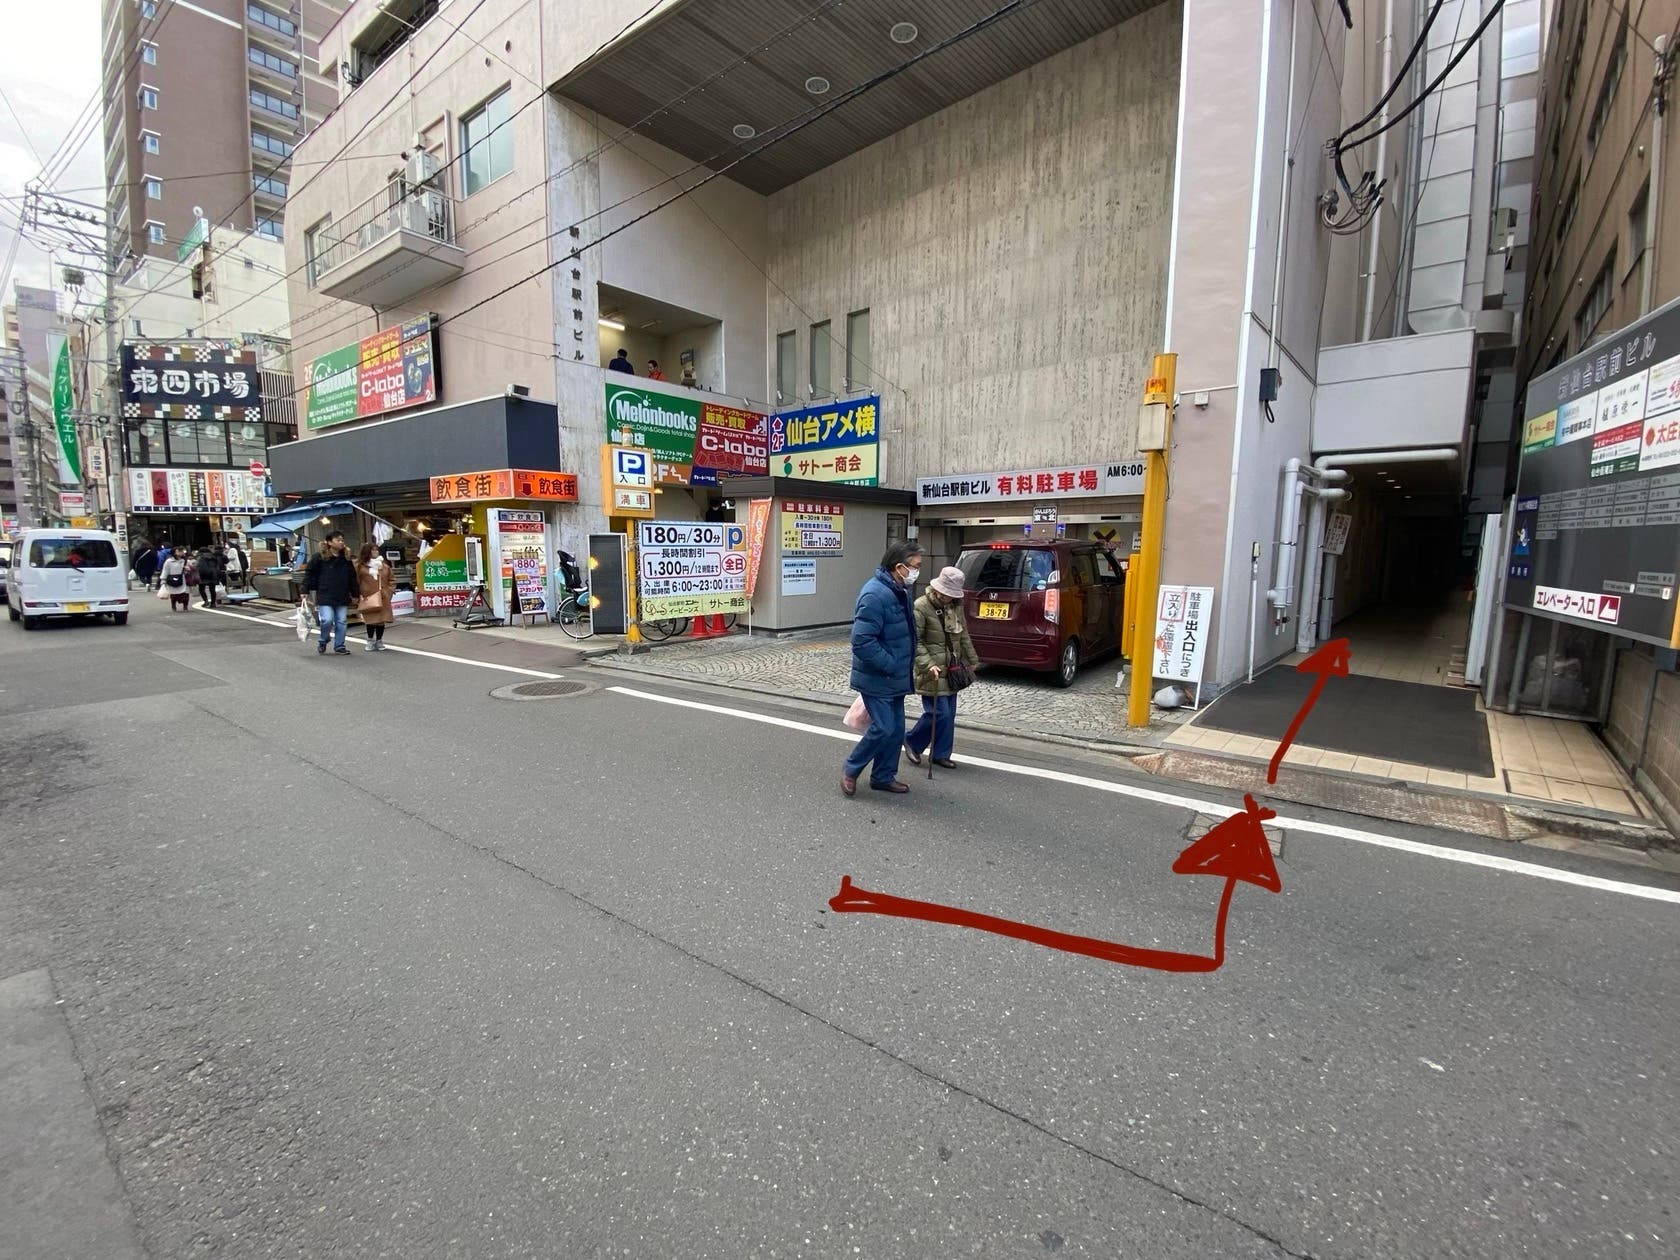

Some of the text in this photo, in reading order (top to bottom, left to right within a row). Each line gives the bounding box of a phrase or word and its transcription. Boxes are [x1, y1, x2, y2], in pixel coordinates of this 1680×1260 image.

[569, 226, 583, 361] 新仙台駅前ビル
[130, 366, 250, 399] 東四市場
[361, 374, 405, 397] C-labo
[383, 390, 405, 408] 仙台店
[616, 399, 697, 432] Melonbooks
[786, 404, 876, 446] 仙台アメ横
[1656, 421, 1680, 445] 太庄
[611, 429, 645, 446] 仙店
[701, 434, 767, 458] C-labo
[771, 433, 784, 453] 2F
[622, 453, 642, 473] P
[745, 456, 767, 468] 仙台店
[798, 454, 861, 476] サトー商会
[436, 474, 492, 500] 飲食街
[539, 477, 575, 496] 飲食街
[620, 474, 646, 485] 入口
[922, 480, 991, 498] 新仙台駅前ビル
[997, 470, 1098, 495] 有料駐車場
[621, 494, 645, 506] 満車
[798, 503, 830, 514] 駐車料金
[645, 526, 721, 544] 180円/30分
[803, 532, 814, 540] 全日
[818, 537, 840, 547] 1,300円
[661, 548, 706, 559] 長時間割引
[517, 559, 536, 569] 880
[647, 560, 719, 576] 1,300円/12時間まで
[725, 559, 744, 571] 全日
[420, 595, 452, 607] 飲食店
[668, 606, 699, 614] イービーンズ
[709, 597, 745, 609] サトー商会
[1536, 591, 1595, 616] エレベーター入口
[985, 608, 1007, 618] 38-78
[1180, 592, 1202, 678] 駐車場出入口につき
